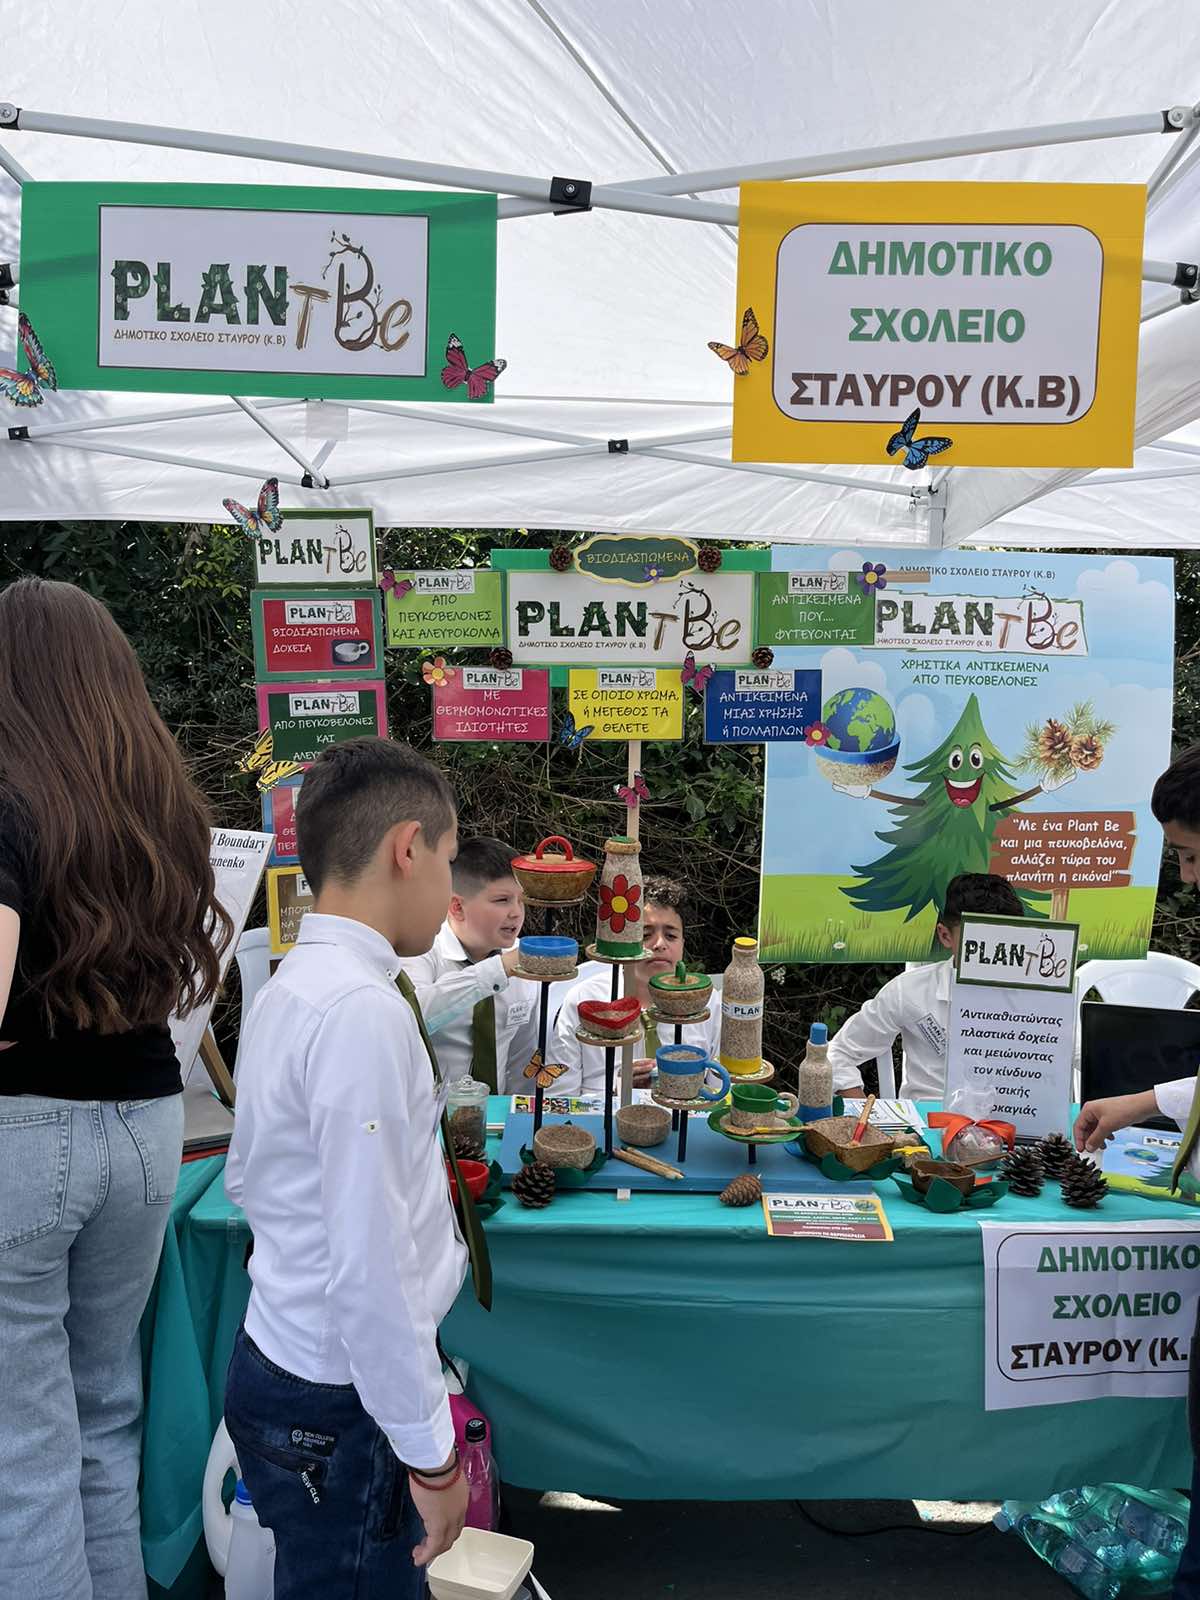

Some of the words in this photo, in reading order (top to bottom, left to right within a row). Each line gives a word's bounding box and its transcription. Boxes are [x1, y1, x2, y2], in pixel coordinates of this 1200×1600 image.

[828, 240, 1053, 277] ΔΗΜΟΤΙΚΟ
[848, 308, 1026, 344] ΣΧΟΛΕΙΟ
[114, 328, 168, 341] ΔΗΜΟΤΙΚΟ
[170, 331, 214, 343] ΣΧΟΛΕΙΟ
[218, 333, 260, 345] ΣΤΑΥΡΟΥ
[263, 335, 287, 347] (Κ.Β)
[789, 371, 972, 408] ΣΤΑΥΡΟΥ
[980, 375, 1081, 416] (Κ.Β)
[586, 552, 690, 564] ΒΙΟΔΙΑΣΠΩΜΕΝΑ
[950, 567, 990, 577] ΣΧΟΛΕΙΟ
[992, 568, 1032, 579] ΣΤΑΥΡΟΥ
[432, 594, 458, 606] ΑΠΟ
[771, 594, 862, 606] ΑΝΤΙΚΕΙΜΕΝΑ
[399, 610, 492, 623] ΠΕΥΚΟΒΕΛΟΝΕΣ
[272, 626, 361, 638] ΒΙΟΔΙΑΣΠΩΜΕΝΑ
[392, 628, 416, 639] ΚΑΙ
[418, 627, 500, 640] ΑΛΕΥΡΟΚΟΛΛΑ
[774, 628, 857, 641] ΦΥΤΕΥΟΝΤΑΙ
[272, 643, 312, 654] ΔΟΧΕΙΑ
[518, 641, 559, 649] ΔΗΜΟΤΙΚΟ
[560, 641, 594, 649] ΣΧΟΛΕΙΟ
[595, 641, 628, 649] ΣΤΑΥΡΟΥ
[911, 638, 943, 646] ΣΧΟΛΕΙΟ
[945, 639, 975, 648] ΣΤΑΥΡΟΥ
[901, 659, 961, 671] ΧΡΗΣΤΙΚΑ
[966, 660, 1050, 673] ΑΝΤΙΚΕΙΜΕΝΑ
[912, 674, 942, 685] ΑΠΟ
[945, 675, 1039, 687] ΠΕΥΚΟΒΕΛΟΝΕΣ
[483, 690, 501, 702] ΜΕ
[573, 689, 589, 700] ΣΕ
[591, 689, 635, 701] ΟΠΟΙΟ
[719, 691, 808, 703] ΑΝΤΙΚΕΙΜΕΝΑ
[435, 705, 549, 718] ΘΕΡΜΟΜΟΝΩΤΙΚΕΣ
[593, 706, 649, 718] ΜΕΓΕΘΟΣ
[652, 706, 669, 717] ΤΑ
[723, 707, 756, 720] ΜΙΑΣ
[758, 706, 804, 719] ΧΡΗΣΗΣ
[274, 720, 296, 731] ΑΠΟ
[298, 716, 374, 730] ΠΕΥΚΟΒΕΛΟΝΕΣ
[455, 721, 529, 734] ΙΔΙΟΤΗΤΕΣ
[602, 723, 649, 734] ΘΕΛΕΤΕ
[732, 725, 804, 738] ΠΟΛΛΑΠΛΩΝ
[316, 734, 336, 744] ΚΑΙ
[1042, 819, 1063, 832] ένα
[1067, 819, 1099, 832] Plant
[1104, 819, 1120, 832] Be
[217, 833, 267, 853] Boundary
[1000, 838, 1019, 849] και
[1023, 840, 1043, 850] μια
[1010, 853, 1055, 867] αλλάζει
[1061, 856, 1091, 867] τώρα
[1096, 857, 1117, 866] του
[1006, 871, 1055, 883] πλανήτη
[1059, 873, 1067, 884] η
[734, 1006, 760, 1015] PLAN
[961, 1029, 1015, 1041] πλαστικά
[1018, 1030, 1059, 1045] δοχεία
[963, 1046, 983, 1056] και
[985, 1048, 1054, 1063] μειώνοντας
[973, 1065, 993, 1075] τον
[995, 1063, 1042, 1079] κίνδυνο
[995, 1086, 1031, 1098] σικής
[1036, 1244, 1200, 1273] ΔΗΜΟΤΙΚΟ
[1052, 1291, 1181, 1319] ΣΧΟΛΕΙΟ
[1010, 1339, 1143, 1370] ΣΤΑΥΡΟΥ
[1148, 1337, 1189, 1367] (Κ.
